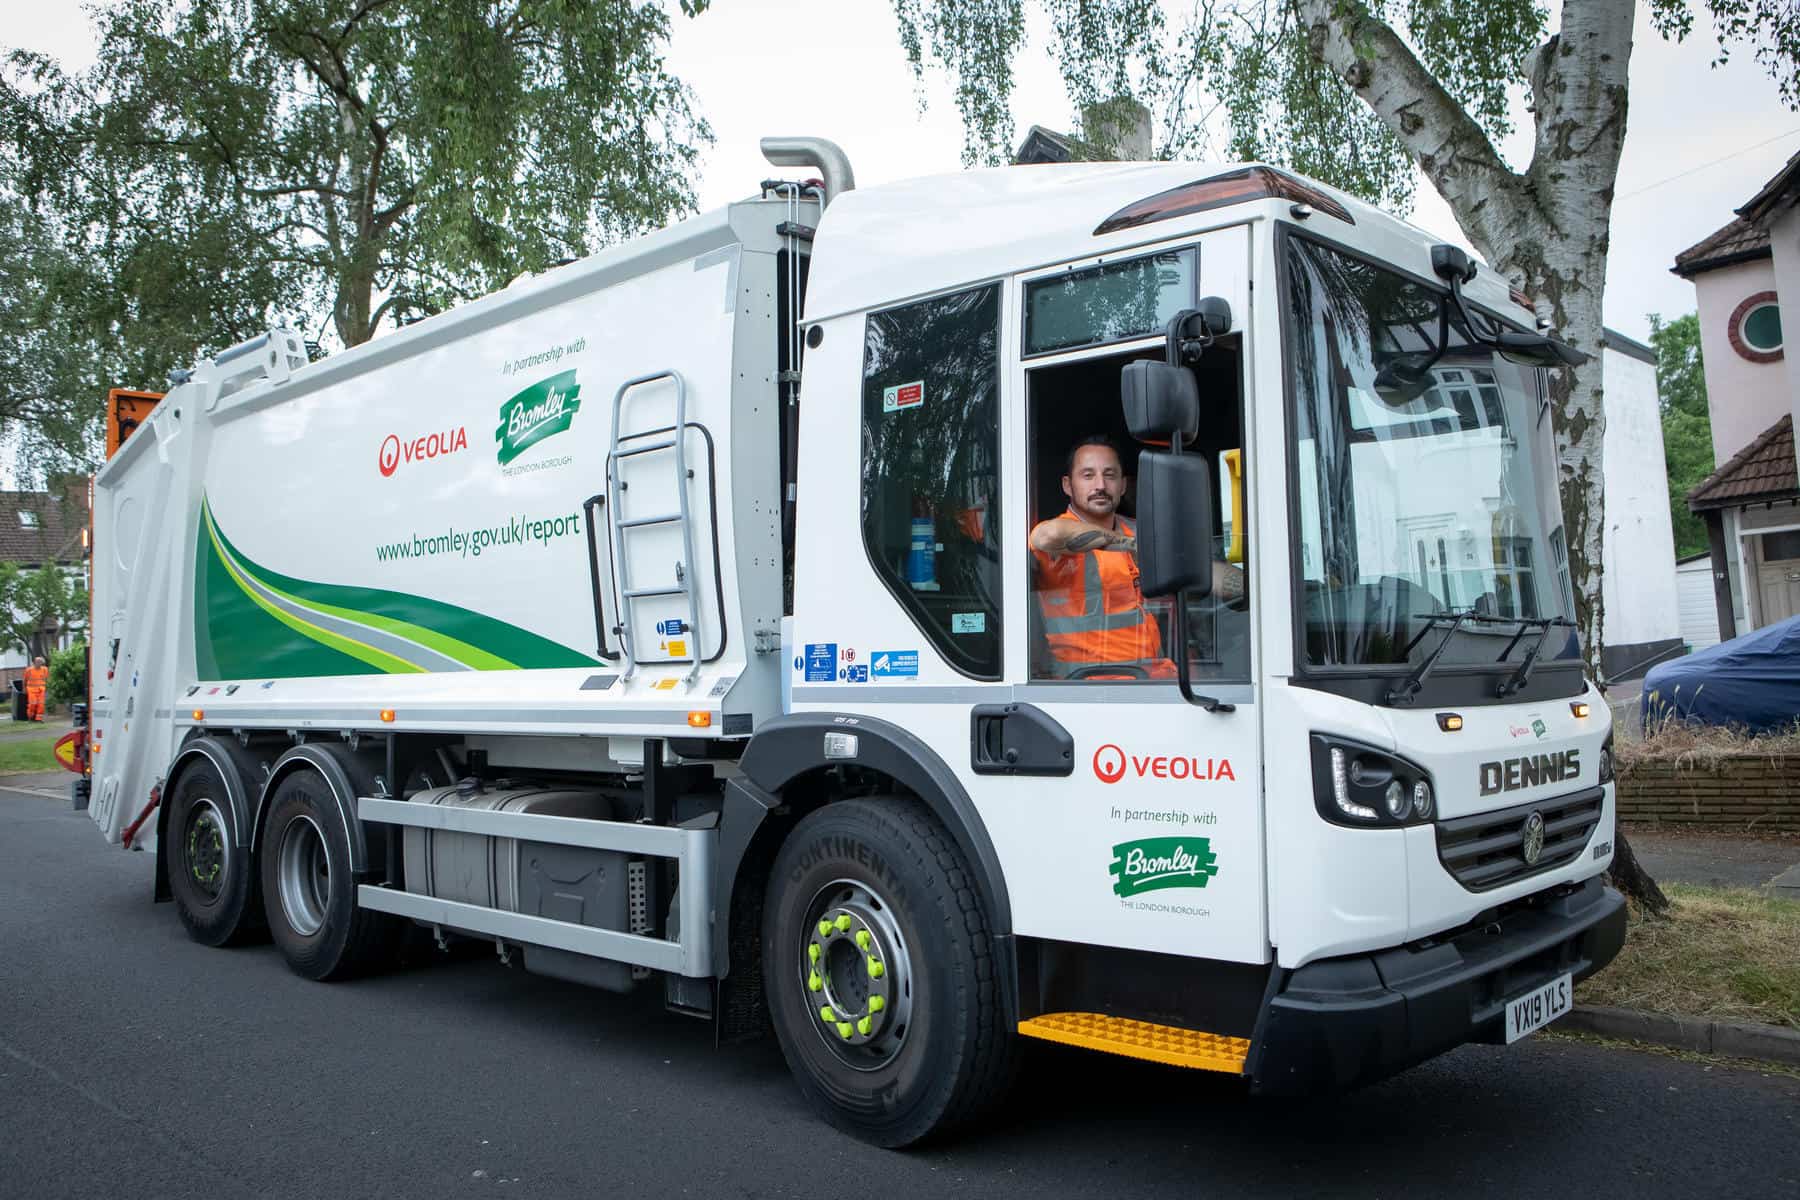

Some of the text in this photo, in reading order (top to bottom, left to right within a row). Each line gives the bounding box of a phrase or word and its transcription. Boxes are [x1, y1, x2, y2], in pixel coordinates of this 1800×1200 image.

[503, 336, 585, 376] In partnership with
[507, 386, 567, 440] Bromley
[403, 427, 468, 464] VEOLIA
[376, 511, 580, 562] www.bromley.gov.uk/report
[1132, 756, 1236, 782] VEOLIA
[1480, 749, 1580, 797] DENNIS
[1111, 806, 1217, 826] In partnership with
[1125, 845, 1200, 877] Bromley
[1120, 900, 1210, 917] THE LONDON BOROUGH
[1514, 981, 1566, 1034] VX19 YLS
